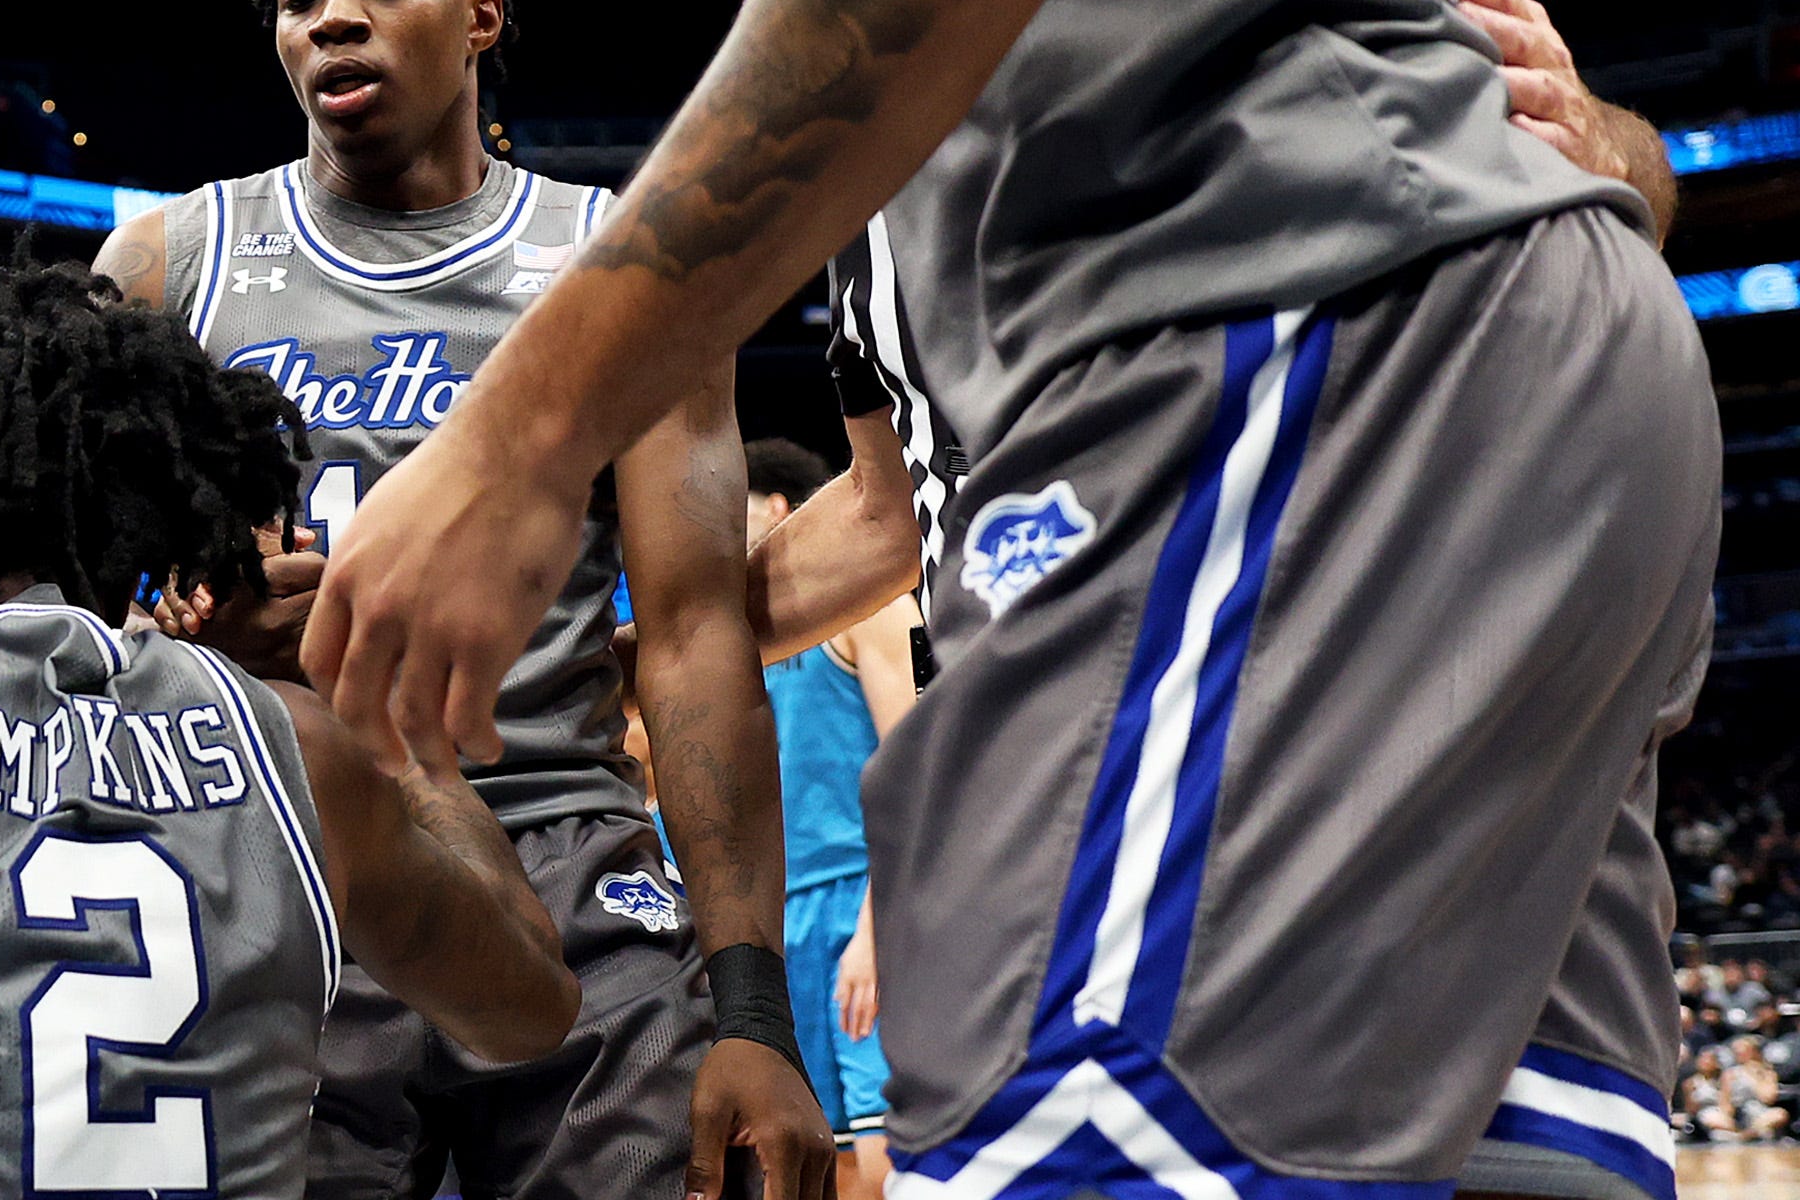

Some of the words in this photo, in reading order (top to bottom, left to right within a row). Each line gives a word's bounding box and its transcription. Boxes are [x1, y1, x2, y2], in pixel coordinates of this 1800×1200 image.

[239, 232, 263, 246] BE
[265, 232, 296, 245] THE
[231, 242, 296, 257] CHANGE
[15, 833, 214, 1196] 2
